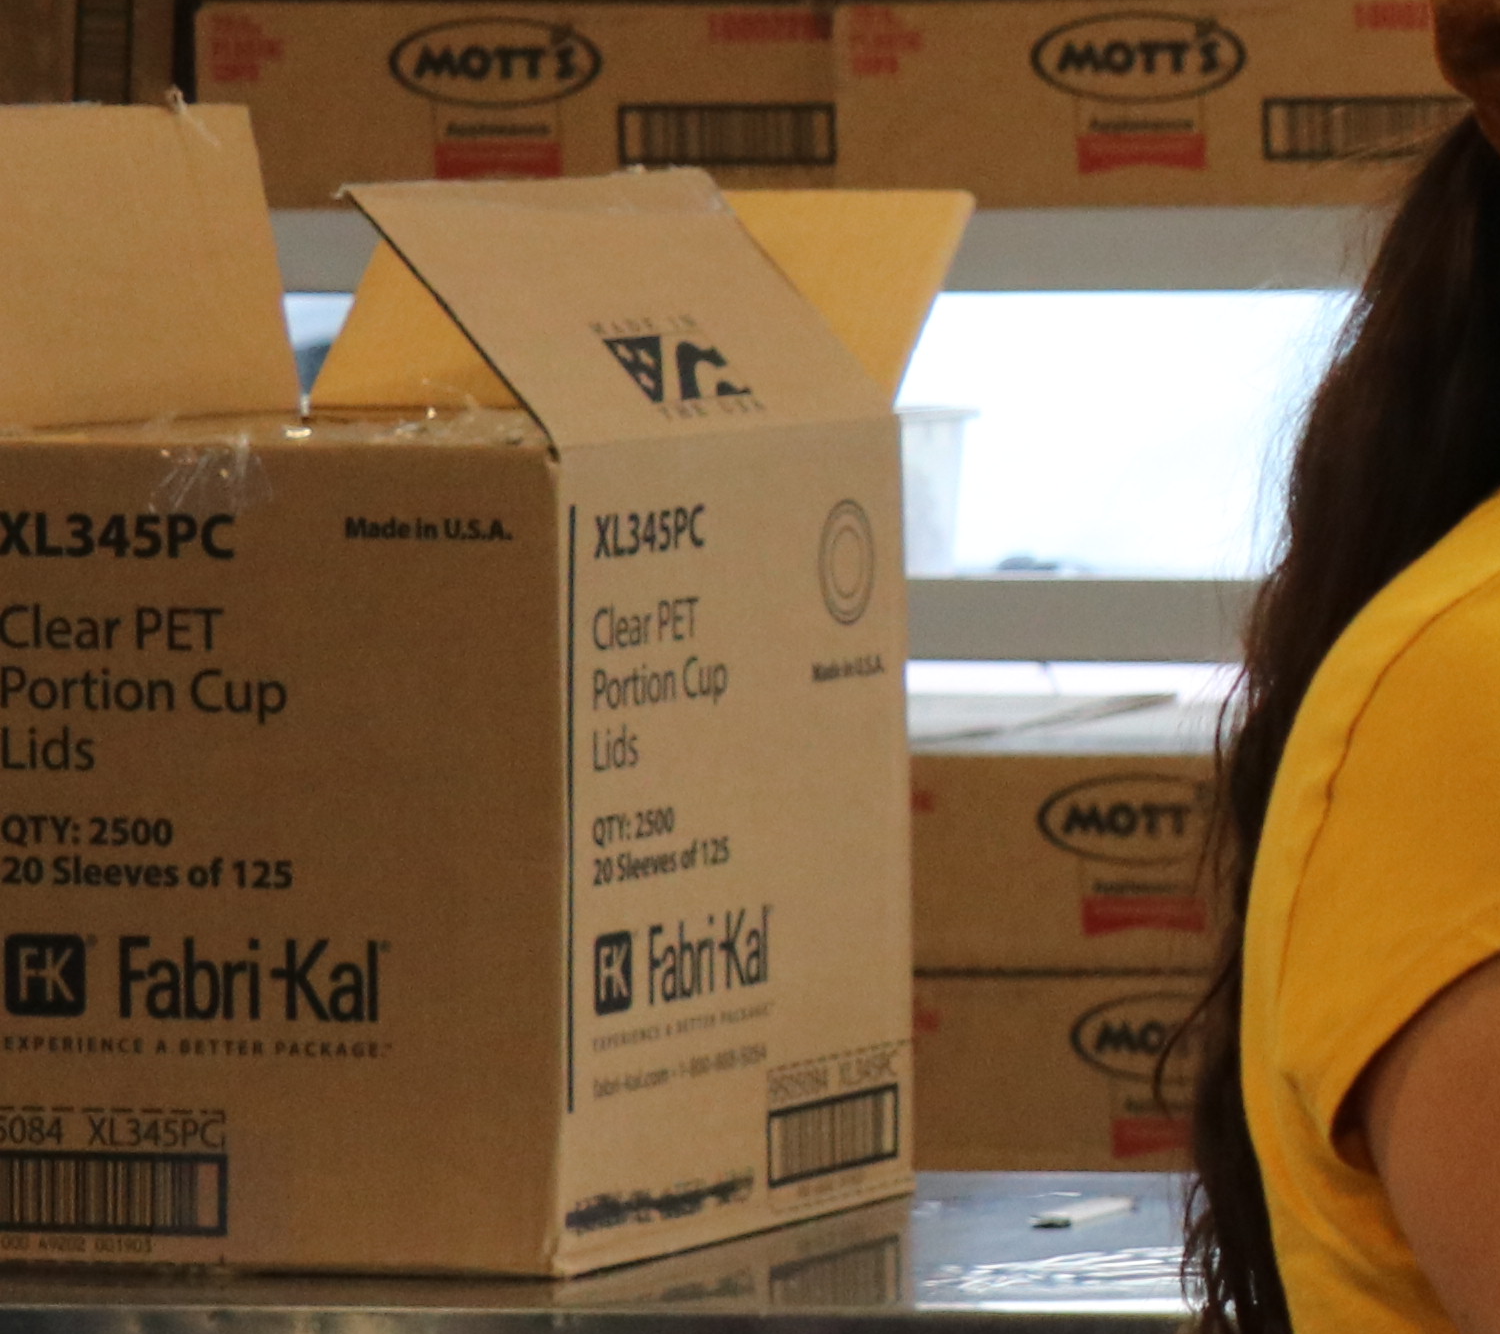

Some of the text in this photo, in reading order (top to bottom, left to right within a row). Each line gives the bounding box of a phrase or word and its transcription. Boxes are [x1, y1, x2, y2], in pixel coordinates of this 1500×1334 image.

[412, 42, 579, 82] MOTT'S
[1055, 34, 1225, 75] MOTT'S
[0, 511, 236, 559] XL345PC
[344, 517, 514, 542] Made in U.S.A.
[593, 503, 706, 559] XL345PC
[0, 604, 225, 652] Clear PET
[592, 596, 700, 652] Clear PET
[0, 667, 288, 725] Portion Cup
[592, 655, 729, 712] Portion Cup
[0, 724, 97, 772] Lids
[592, 723, 641, 773] Lids
[1, 814, 175, 850] QTY: 2500
[592, 806, 676, 849] QTY: 2500
[0, 855, 295, 892] 20 Sleeves of 125
[592, 835, 731, 888] 20 Sleeves of 125
[117, 934, 383, 1025] Fabri-Kal
[647, 905, 770, 1007] Fabri-Kal
[2, 1034, 144, 1056] EXPERIENCE
[155, 1039, 169, 1056] A
[178, 1038, 265, 1058] BETTER
[88, 1115, 220, 1149] XL345PC
